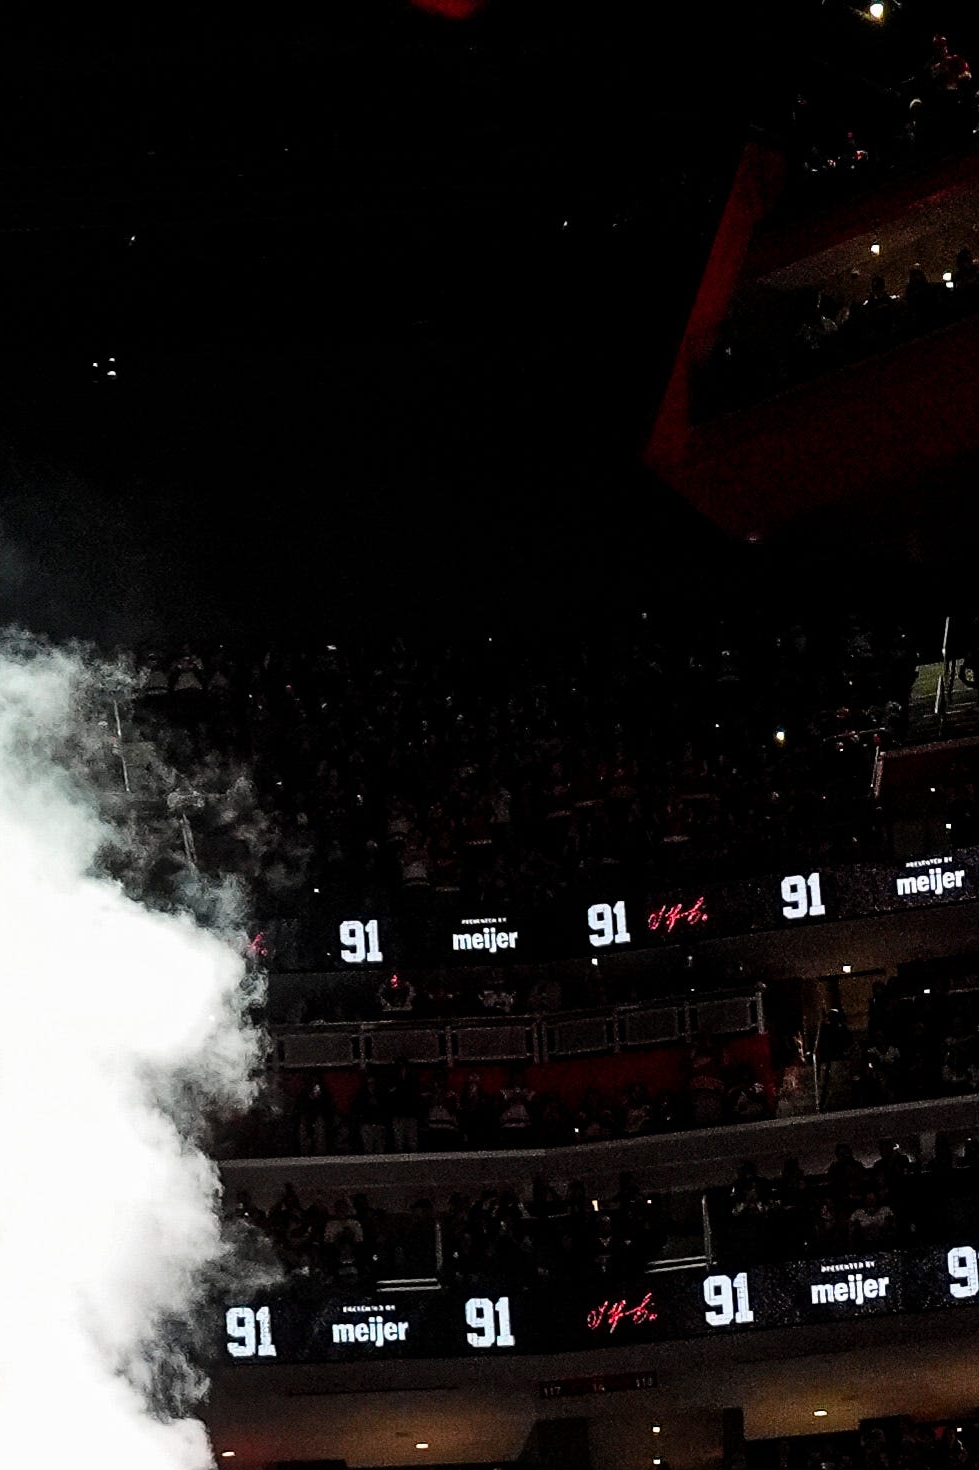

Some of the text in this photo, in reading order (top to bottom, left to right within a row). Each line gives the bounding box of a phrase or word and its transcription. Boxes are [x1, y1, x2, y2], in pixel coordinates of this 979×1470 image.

[781, 872, 826, 919] 91
[896, 868, 965, 895] meijer
[339, 919, 383, 963] 91
[452, 927, 518, 953] meijer
[587, 901, 631, 947] 91
[811, 1273, 890, 1305] meijer
[948, 1246, 979, 1298] 9
[703, 1272, 754, 1326] 91
[226, 1306, 277, 1357] 91
[332, 1316, 409, 1347] meijer
[465, 1297, 515, 1348] 91
